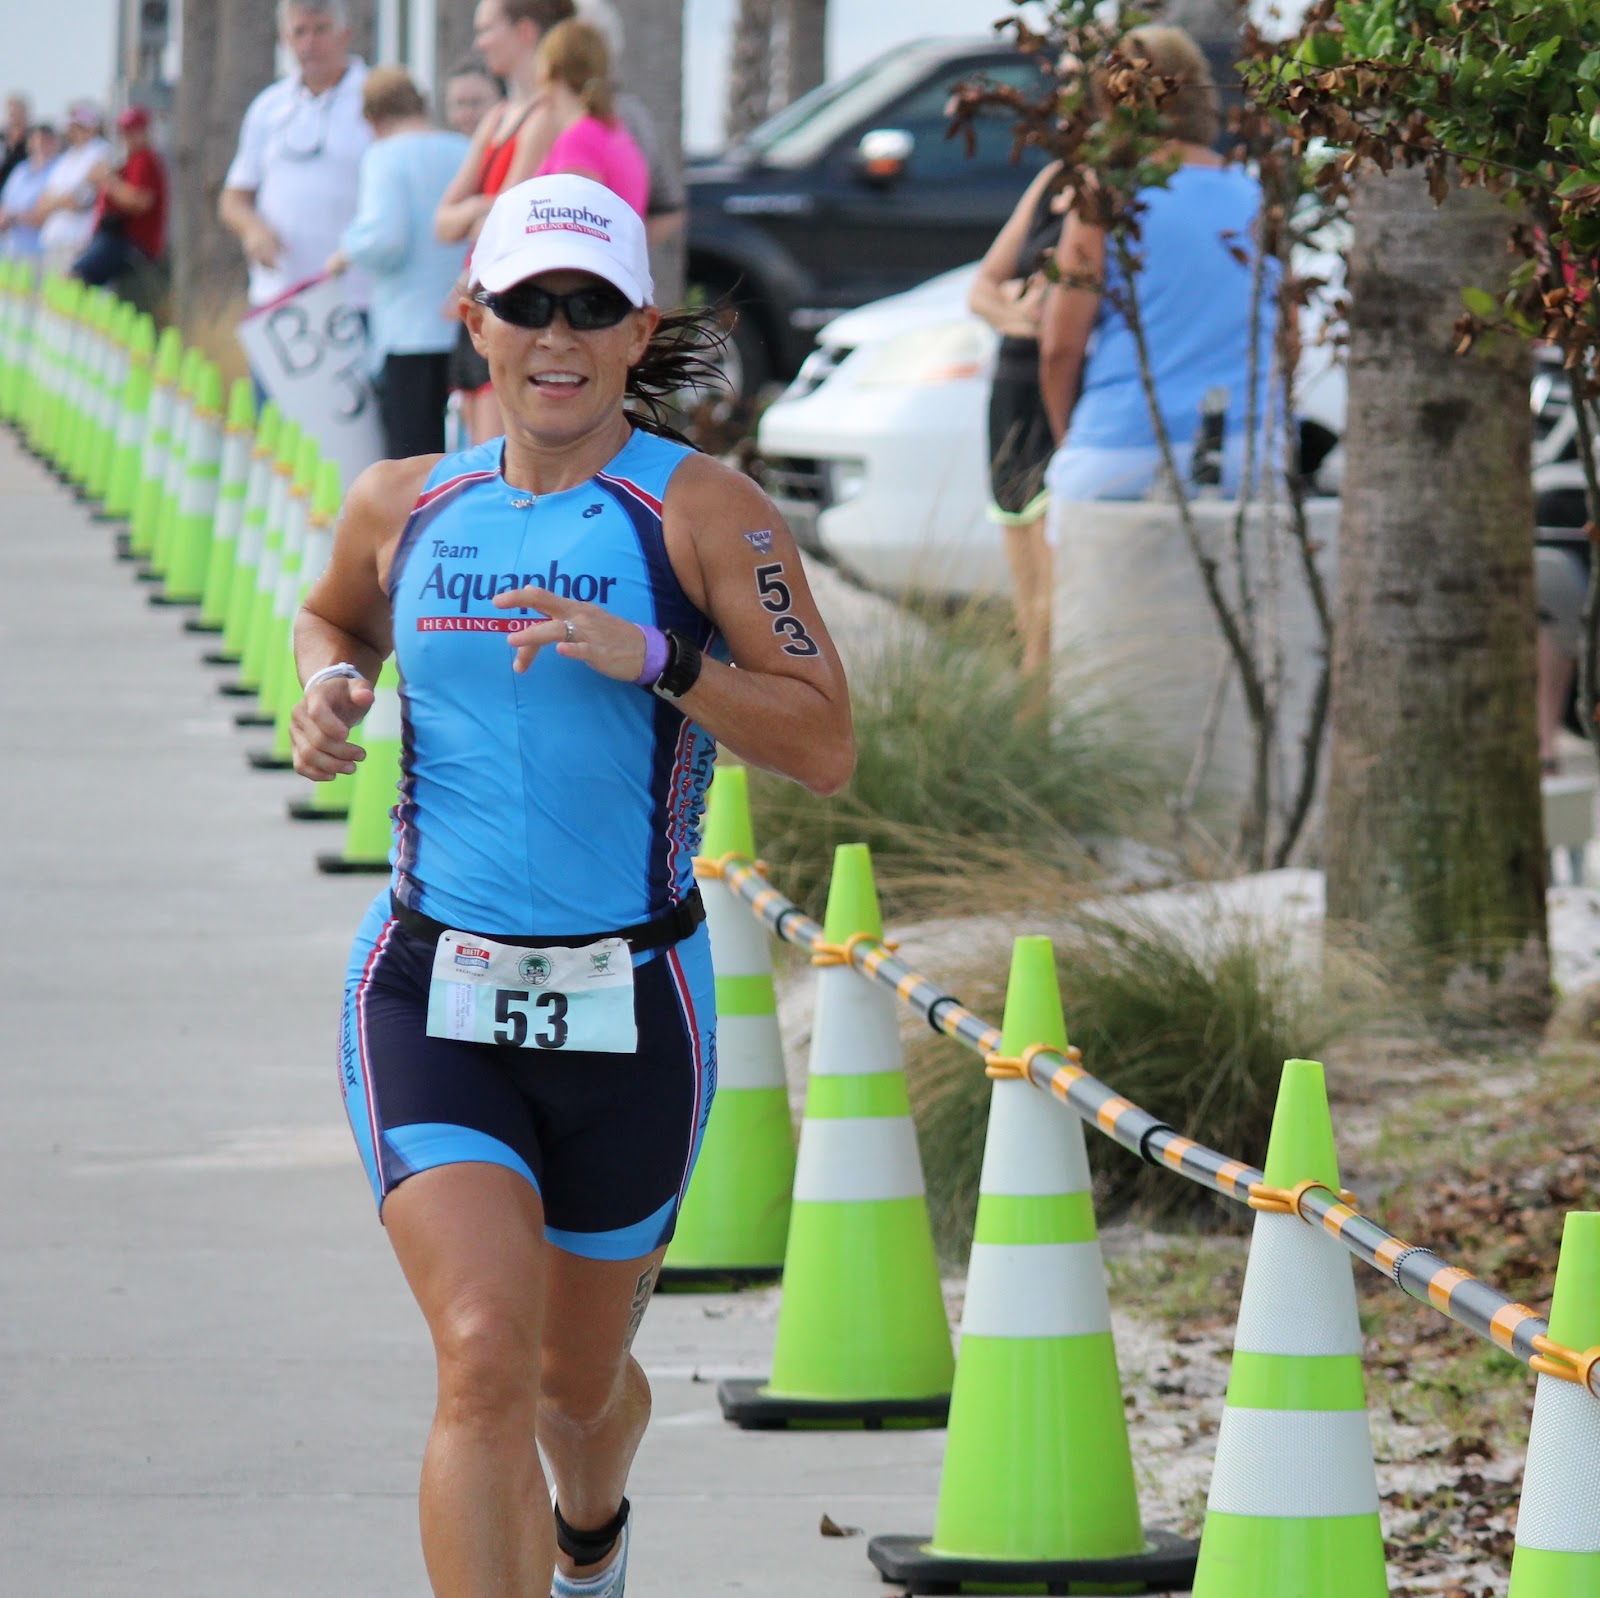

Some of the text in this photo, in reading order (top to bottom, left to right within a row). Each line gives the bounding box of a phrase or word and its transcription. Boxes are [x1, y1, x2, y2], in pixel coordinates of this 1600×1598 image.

[530, 198, 551, 206] Team
[527, 205, 612, 228] Aquaphor
[528, 222, 609, 240] HEALING OINTMENT
[431, 540, 478, 559] Team
[418, 560, 617, 614] Aquaphor
[423, 618, 499, 631] HEALING
[493, 989, 569, 1049] 53
[342, 988, 359, 1087] Aquaphor
